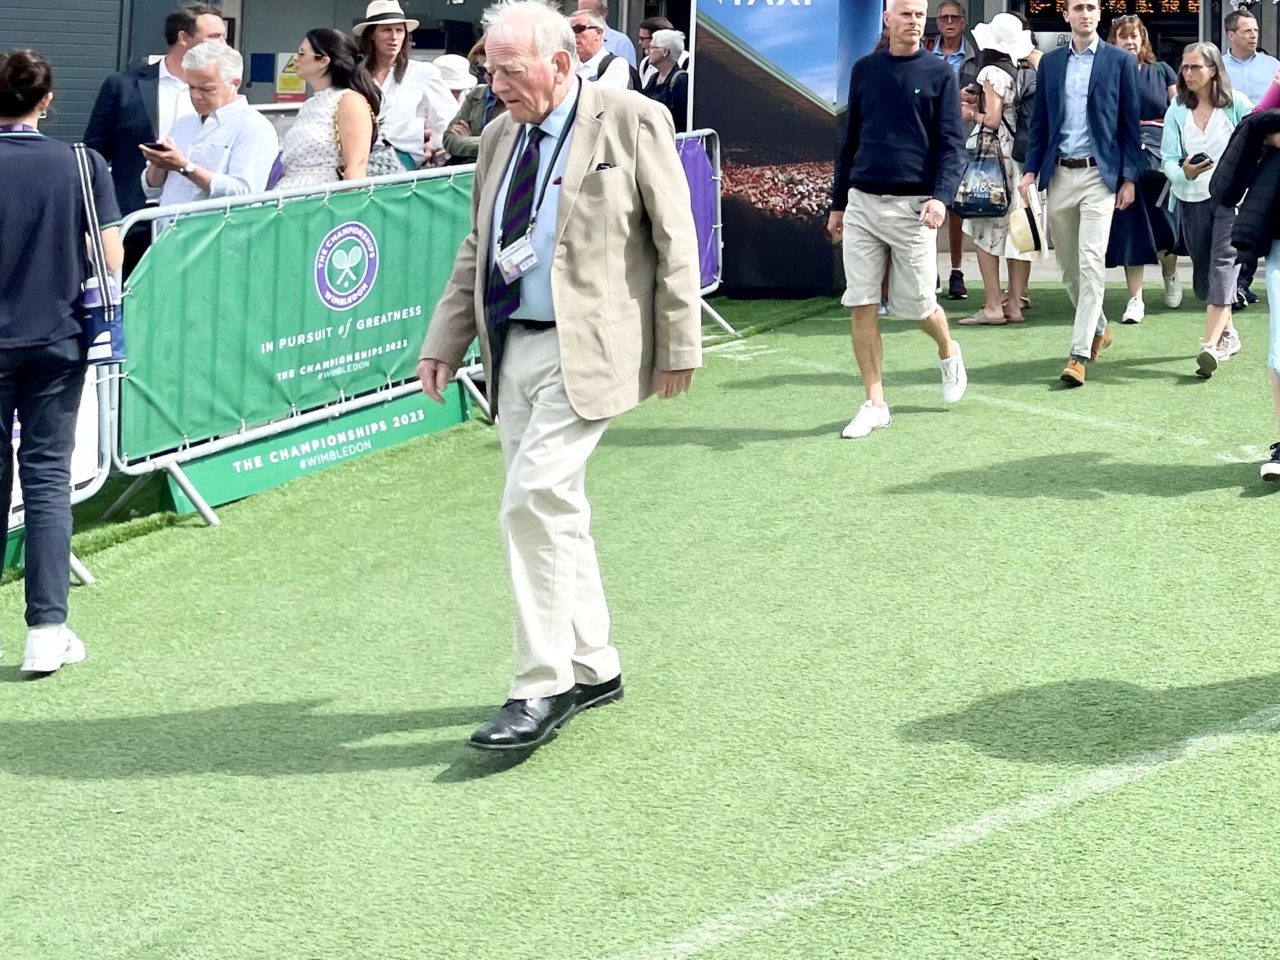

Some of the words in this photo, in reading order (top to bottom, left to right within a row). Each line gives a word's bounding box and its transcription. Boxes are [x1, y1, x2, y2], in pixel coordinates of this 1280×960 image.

[967, 181, 997, 193] M&S
[317, 247, 328, 269] THE
[325, 226, 375, 259] CHAMPIONSHIPS
[325, 282, 369, 306] WIMBLEDON
[261, 340, 274, 354] IN
[279, 327, 333, 350] PURSUIT
[337, 317, 352, 339] of
[356, 304, 422, 331] GREATNESS
[276, 369, 295, 382] THE
[299, 346, 383, 376] CHAMPIONSHIPS
[385, 339, 408, 353] 2023
[317, 360, 370, 381] #WIMBLEDON
[232, 455, 263, 474] THE
[269, 419, 388, 464] CHAMPIONSHIPS
[393, 409, 425, 428] 2023
[300, 439, 372, 470] #WIMBLEDON
